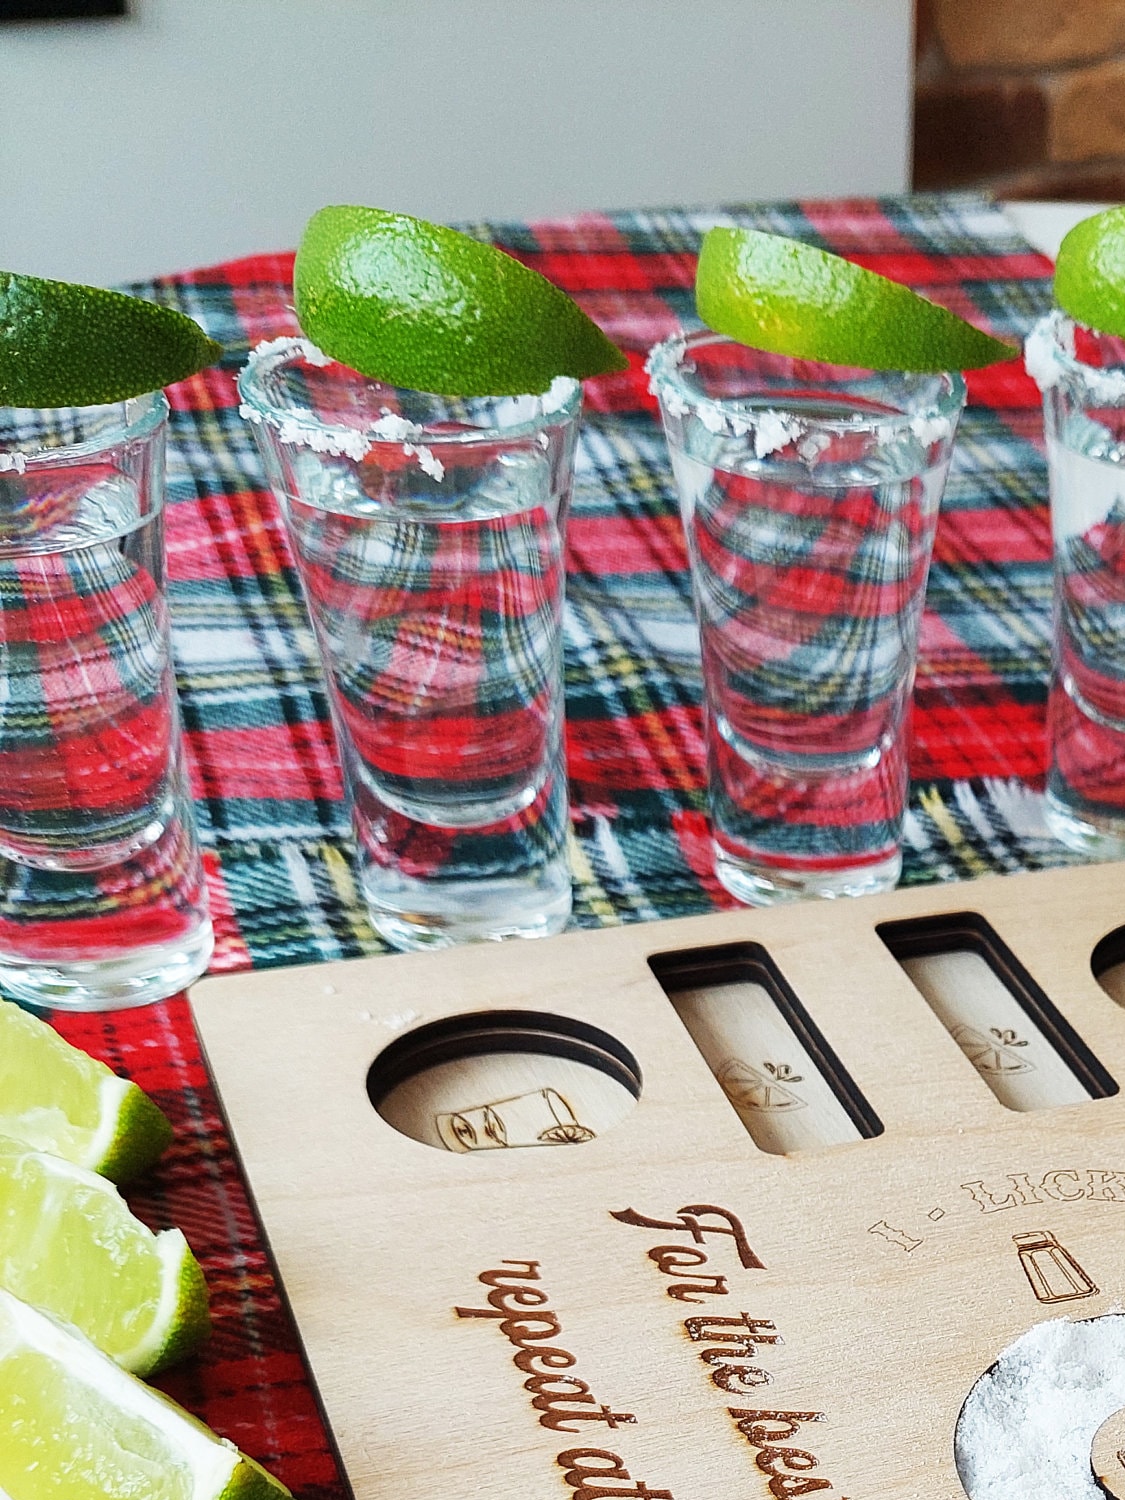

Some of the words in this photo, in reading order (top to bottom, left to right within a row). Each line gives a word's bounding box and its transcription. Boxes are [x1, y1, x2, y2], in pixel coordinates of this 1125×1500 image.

[609, 1203, 768, 1305] For
[868, 1217, 923, 1253] I
[455, 1258, 639, 1435] repeat
[682, 1312, 786, 1397] the
